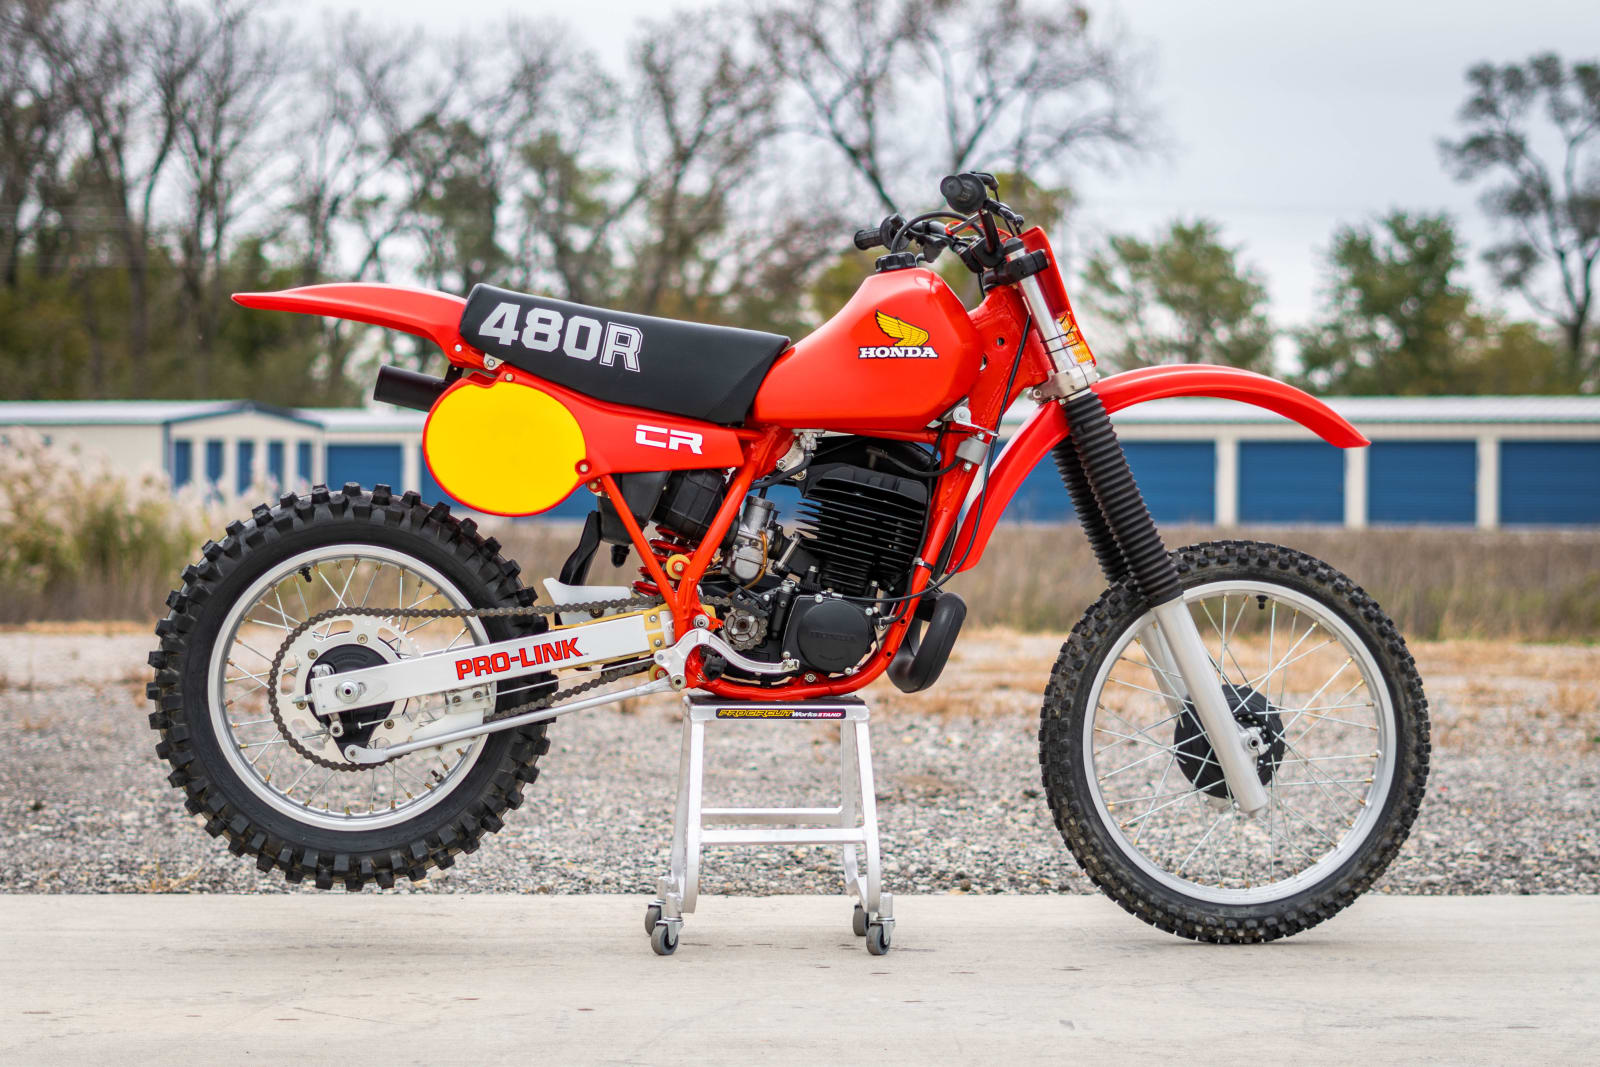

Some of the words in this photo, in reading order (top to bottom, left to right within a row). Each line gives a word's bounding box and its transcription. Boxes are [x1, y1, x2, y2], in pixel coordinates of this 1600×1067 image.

[479, 302, 643, 372] 480R
[859, 346, 938, 359] HONDA
[635, 424, 703, 455] CR
[455, 637, 583, 680] PRO-LINK
